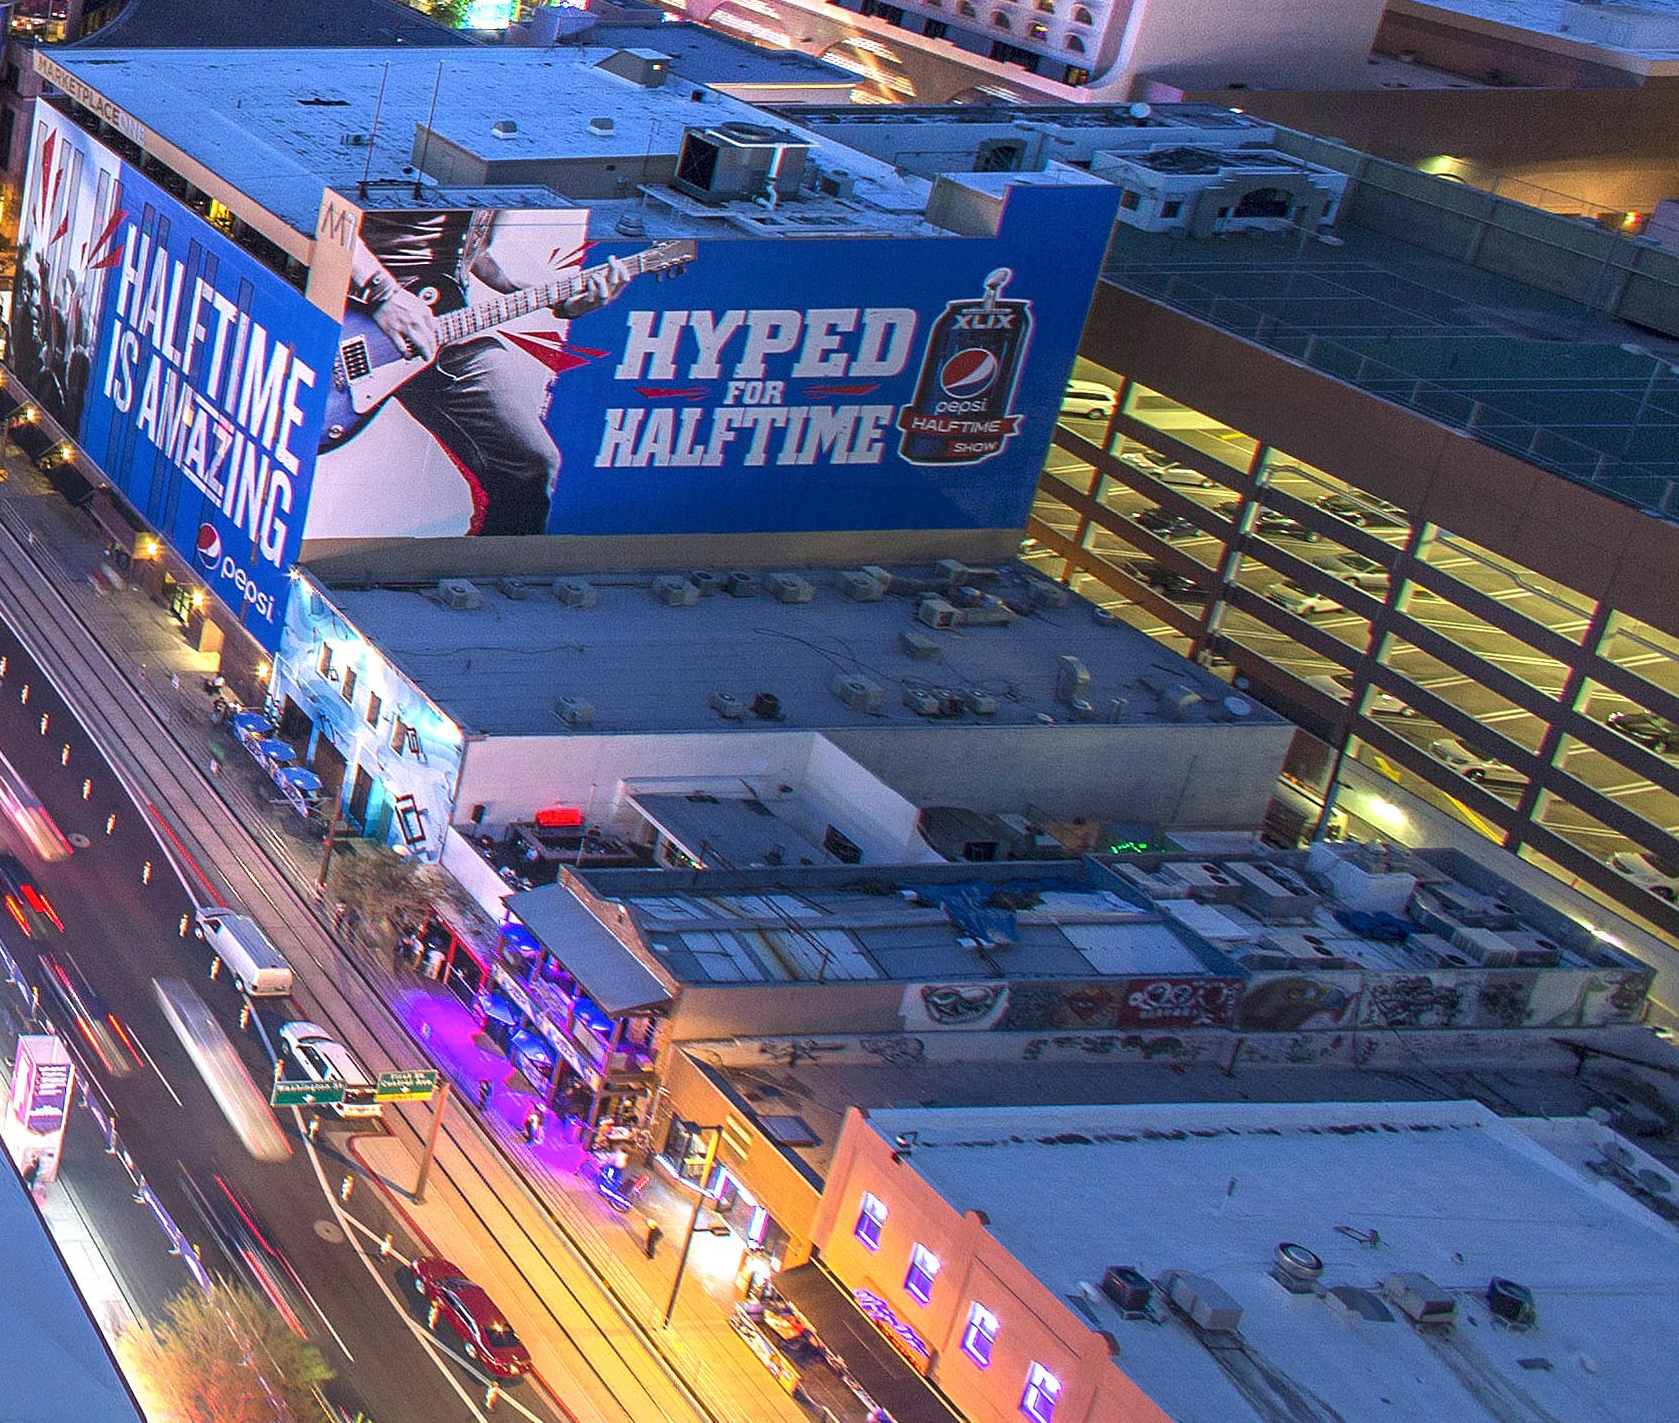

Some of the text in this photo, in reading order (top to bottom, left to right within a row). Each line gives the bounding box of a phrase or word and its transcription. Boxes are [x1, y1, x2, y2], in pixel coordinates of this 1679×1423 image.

[952, 313, 1016, 329] XLIX
[116, 221, 316, 477] HALFTIME
[615, 308, 918, 379] HYPED
[724, 380, 785, 406] FOR
[934, 398, 988, 416] pepsi
[104, 318, 293, 568] IS AMAZING
[595, 405, 895, 467] HALFTIME
[912, 417, 1003, 433] HALFTIME
[953, 441, 999, 453] SHOW
[221, 553, 274, 625] pepsi
